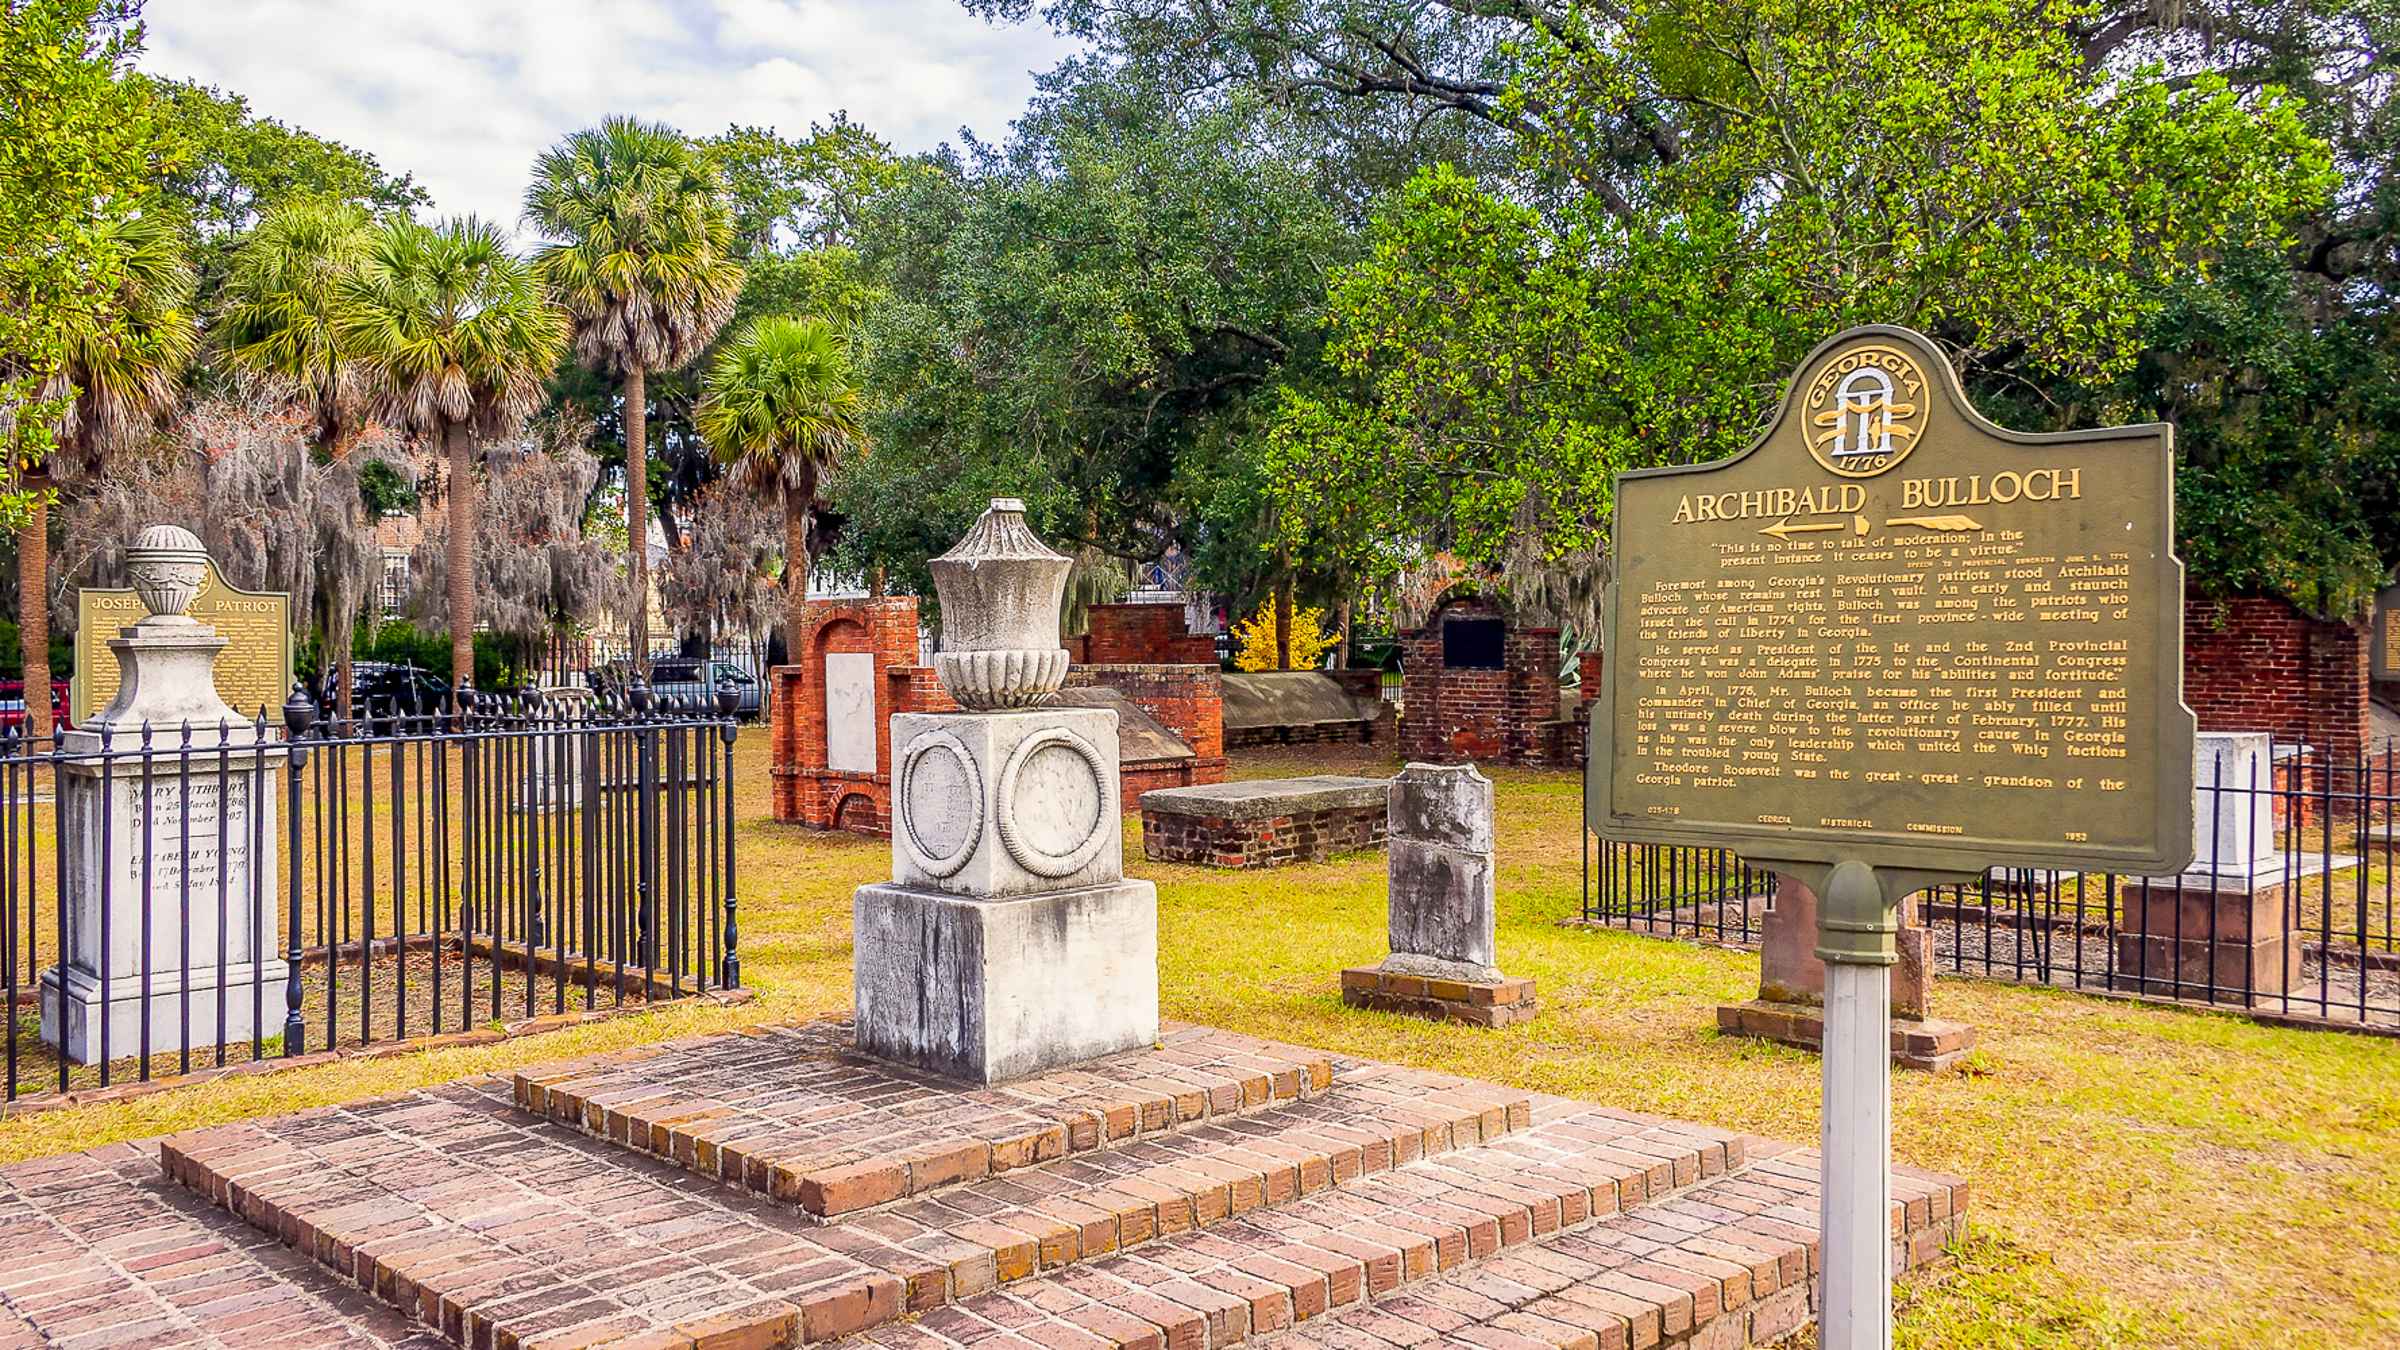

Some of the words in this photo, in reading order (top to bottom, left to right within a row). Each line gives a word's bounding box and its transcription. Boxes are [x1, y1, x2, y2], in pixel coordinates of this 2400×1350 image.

[1810, 352, 1922, 409] GEORGIA
[1839, 454, 1888, 471] 1776
[1672, 484, 1867, 524] ARCHIBALD
[1902, 468, 2081, 509] BULLOCH
[1767, 543, 1782, 552] no
[1788, 540, 1815, 551] time
[1841, 537, 1865, 548] talk
[2001, 530, 2023, 541] the
[1720, 555, 1765, 568] present
[1774, 553, 1823, 564] instance
[1851, 550, 1893, 560] ceases
[1656, 580, 1706, 591] Foremost
[1717, 579, 1755, 589] among
[1768, 576, 1825, 588] Georgia's
[1837, 573, 1925, 585] Revolutionary
[1938, 570, 1990, 583] patriots
[2005, 568, 2042, 579] stood
[2058, 565, 2129, 577] Archibald
[1641, 594, 1681, 603] Bulloch
[1695, 592, 1728, 600] whose
[1740, 590, 1785, 600] remains
[1797, 589, 1821, 598] rest
[1856, 587, 1879, 597] this
[1940, 583, 1958, 594] An
[1971, 583, 2008, 594] early
[2024, 581, 2050, 592] and
[2070, 579, 2128, 591] staunch
[91, 597, 146, 611] JOSEP
[215, 600, 279, 612] PATRIOT
[1640, 606, 1689, 615] advocate
[1719, 604, 1774, 613] American
[1838, 600, 1884, 611] Bulloch
[1936, 599, 1978, 610] among
[1993, 596, 2016, 607] the
[2031, 595, 2086, 608] patriots
[2099, 594, 2128, 604] who
[1640, 618, 1674, 627] issued
[1715, 616, 1736, 626] call
[1768, 616, 1794, 625] 1774
[1808, 615, 1826, 624] for
[1840, 614, 1860, 624] the
[1872, 613, 1901, 623] first
[1918, 611, 1975, 624] province
[1992, 610, 2024, 621] wide
[2040, 609, 2099, 622] meeting
[1668, 629, 1708, 639] friends
[1740, 627, 1785, 639] Liberty
[1818, 627, 1872, 638] Georgia.
[1656, 645, 1670, 654] He
[1682, 645, 1719, 654] served
[1757, 644, 1814, 654] President
[1856, 644, 1877, 653] the
[1926, 642, 1950, 652] and
[2006, 641, 2033, 651] 2nd
[2049, 640, 2127, 650] Provincial
[1640, 657, 1690, 667] Congress
[1719, 658, 1739, 666] was
[1767, 657, 1817, 667] delegate
[1853, 657, 1881, 666] 1775
[1954, 656, 2039, 666] Continental
[2057, 656, 2127, 667] Congress
[1639, 669, 1672, 678] where
[1706, 670, 1728, 678] won
[1738, 669, 1767, 678] John
[1832, 670, 1872, 680] praise
[1883, 670, 1902, 679] for
[1912, 669, 1930, 679] his
[2009, 669, 2034, 680] and
[1770, 687, 1789, 696] Mr.
[1805, 686, 1851, 696] Bulloch
[1867, 687, 1918, 697] became
[1967, 687, 1998, 697] first
[2012, 687, 2082, 698] President
[2099, 688, 2127, 699] and
[1639, 698, 1704, 708] Commander
[1737, 698, 1771, 708] Chief
[1873, 701, 1889, 709] an
[1900, 700, 1940, 711] office
[1984, 702, 2016, 714] ably
[2032, 702, 2072, 712] filled
[2091, 703, 2126, 713] until
[1639, 710, 1654, 719] his
[1665, 711, 1714, 721] untimely
[1729, 711, 1762, 721] death
[1773, 711, 1814, 724] during
[1857, 713, 1894, 723] latter
[1904, 714, 1935, 725] part
[2102, 717, 2126, 728] His
[1638, 722, 1657, 731] loss
[1671, 723, 1689, 732] was
[1718, 725, 1757, 733] severe
[1769, 724, 1797, 734] blow
[1868, 726, 1960, 739] revolutionary
[1978, 731, 2020, 739] cause
[2064, 731, 2125, 745] Georgia
[1656, 747, 1673, 756] the
[1682, 748, 1730, 758] troubled
[1742, 750, 1779, 761] young
[1791, 751, 1827, 762] State.
[1660, 735, 1675, 744] his
[1719, 736, 1736, 746] the
[1750, 737, 1775, 748] only
[1788, 737, 1854, 751] leadership
[1867, 740, 1904, 751] which
[1919, 742, 1960, 752] united
[2012, 743, 2049, 758] Whig
[2066, 744, 2127, 757] factions
[1637, 774, 1681, 785] Georgia
[1694, 776, 1736, 788] patriot.
[1654, 762, 1709, 773] Theodore
[1723, 765, 1781, 777] Roosevelt
[1830, 769, 1850, 780] the
[1865, 770, 1901, 782] great
[1921, 773, 1959, 784] great
[1984, 776, 2053, 789] grandson
[129, 787, 175, 799] MRY
[1821, 818, 1872, 828] HISTORICAL
[1907, 823, 1962, 834] COMMISSION
